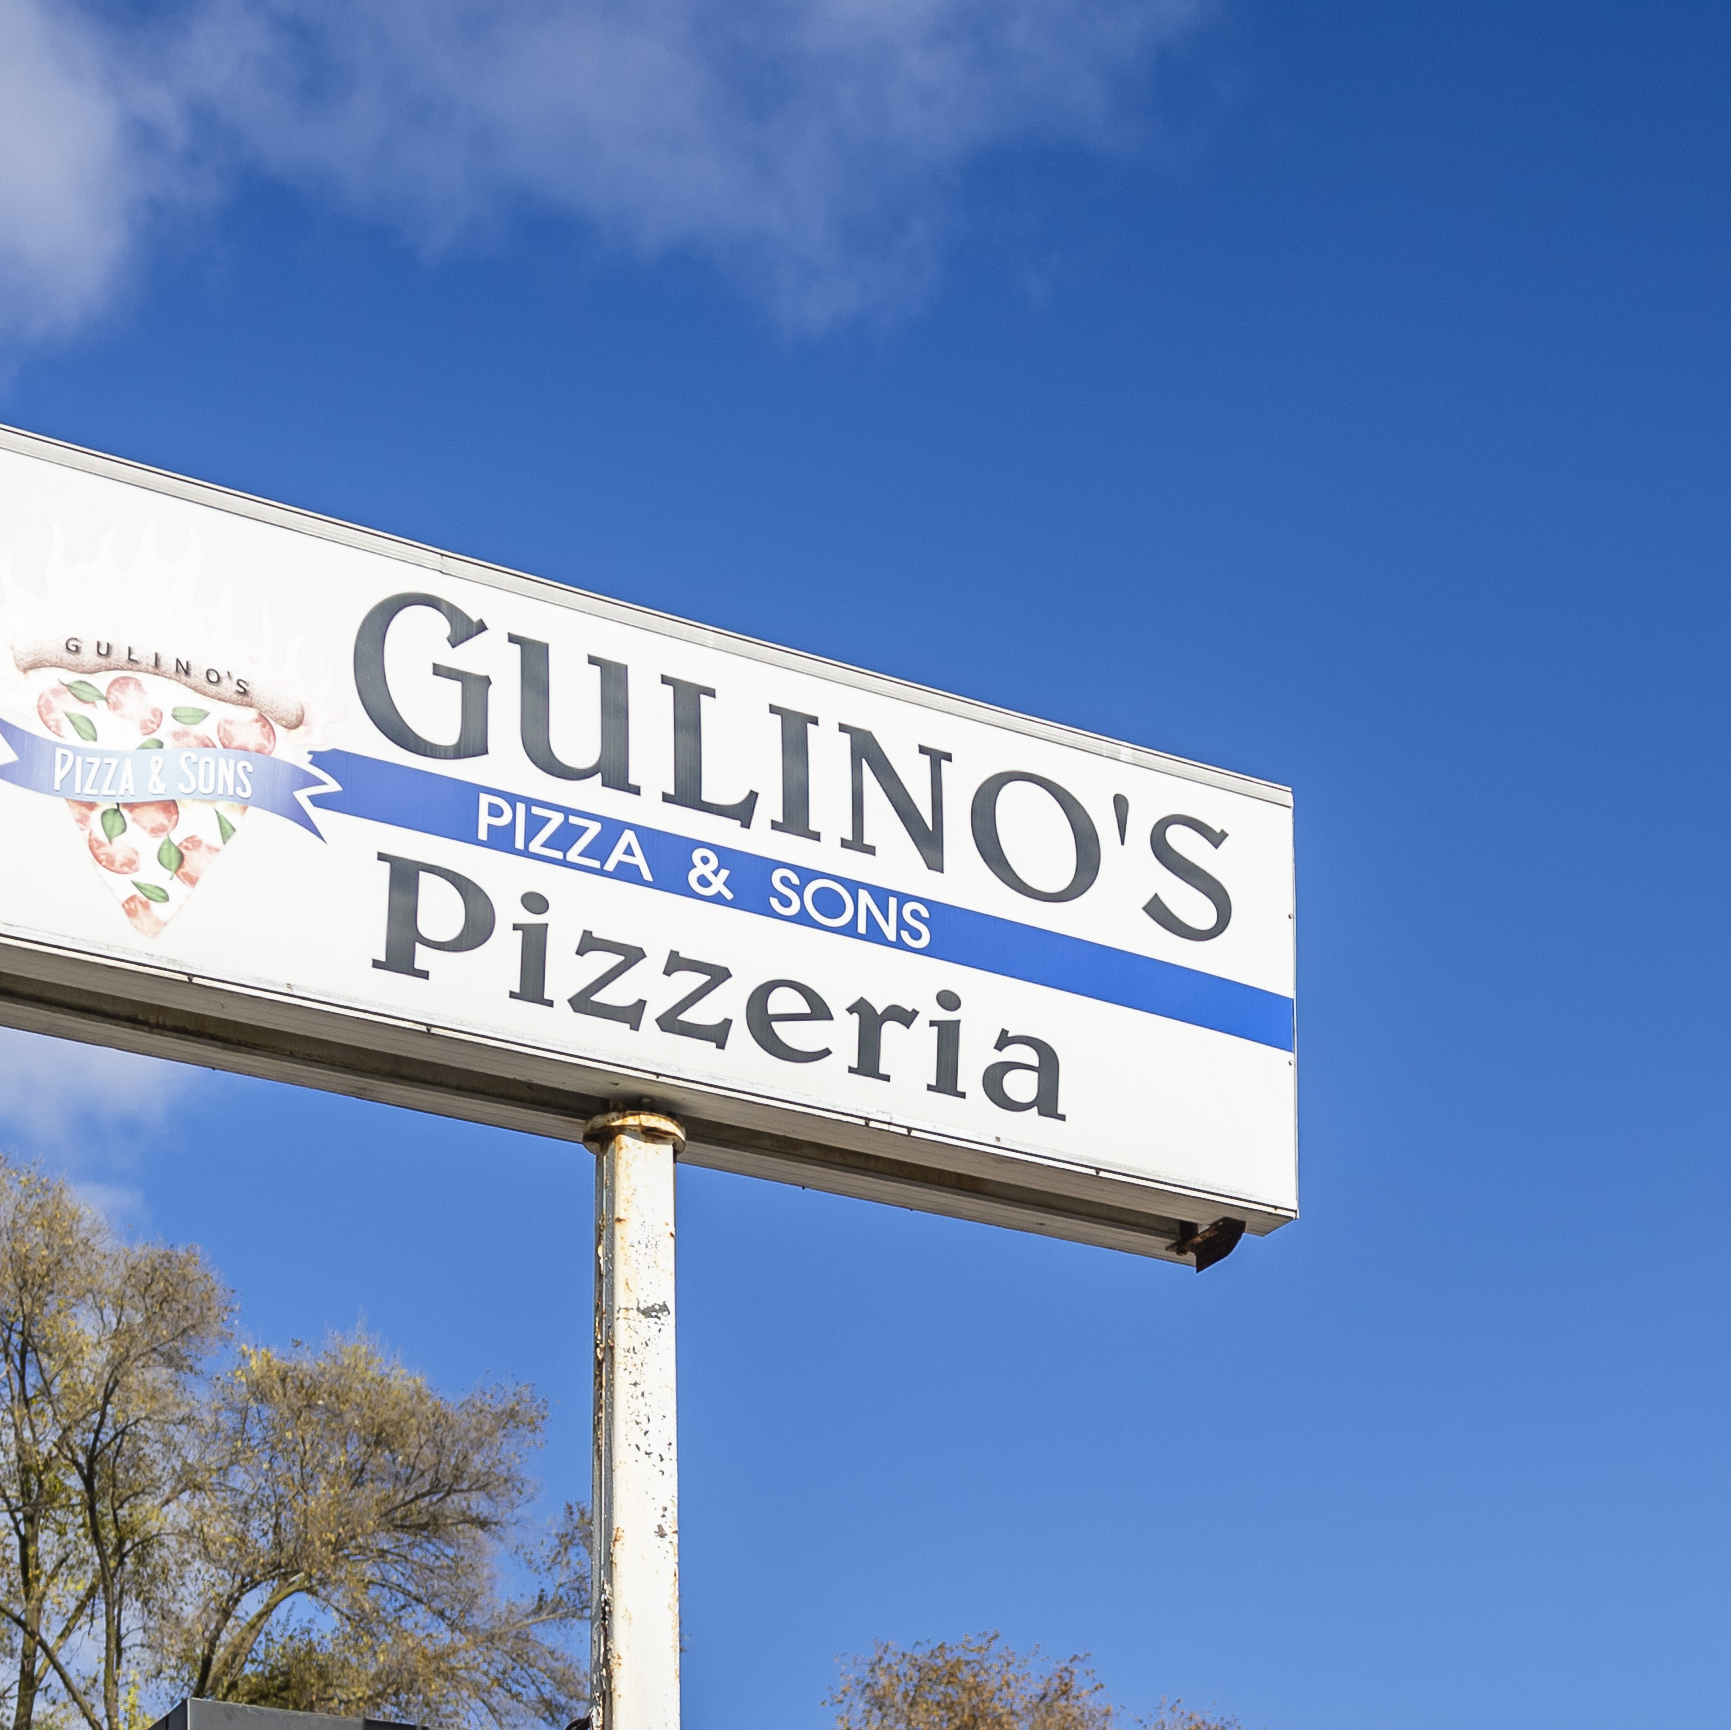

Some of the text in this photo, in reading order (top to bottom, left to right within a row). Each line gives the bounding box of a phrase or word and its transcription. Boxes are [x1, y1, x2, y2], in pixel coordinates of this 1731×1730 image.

[65, 637, 250, 697] GULINO'S
[53, 746, 254, 800] PIZZA & SONS
[353, 592, 1232, 942] GULINO'S
[477, 792, 933, 949] PIZZA & SONS
[371, 851, 1067, 1122] Pizzeria
